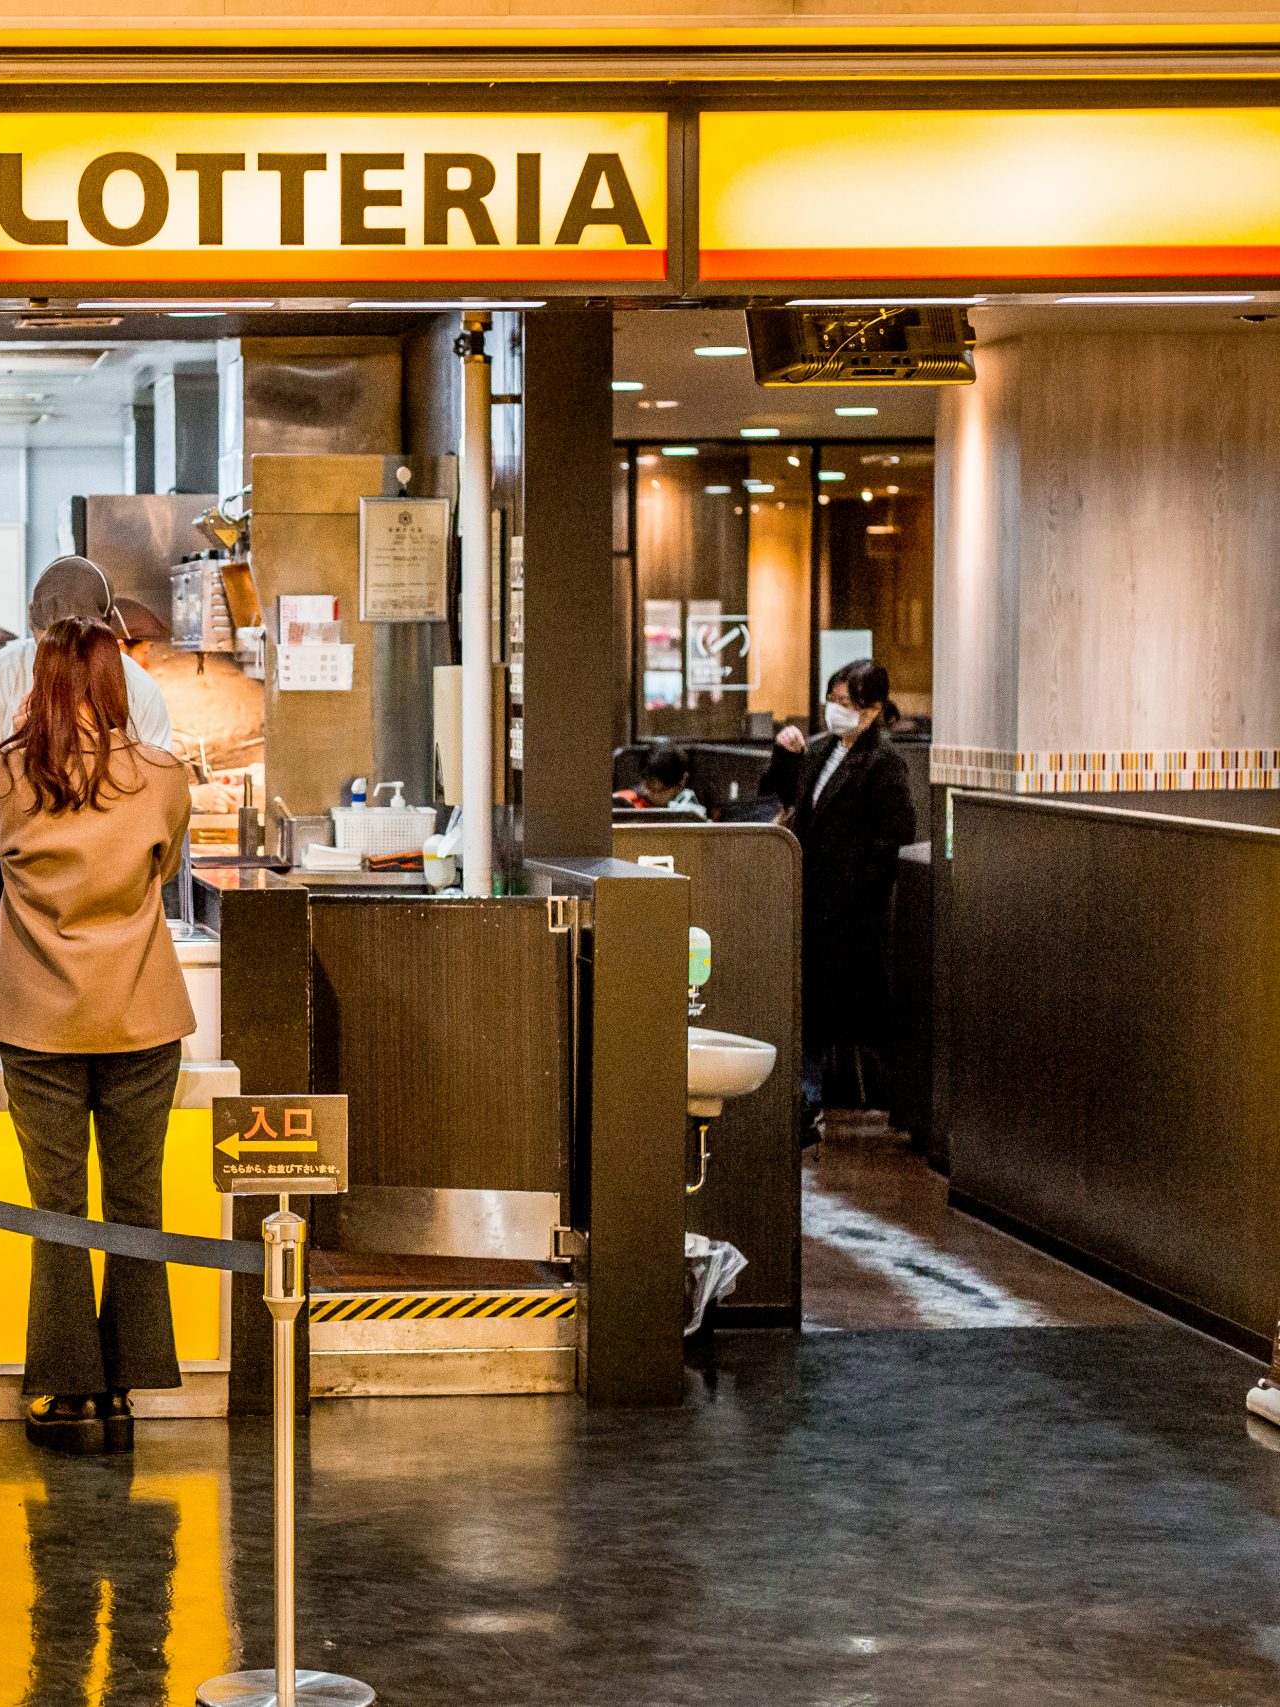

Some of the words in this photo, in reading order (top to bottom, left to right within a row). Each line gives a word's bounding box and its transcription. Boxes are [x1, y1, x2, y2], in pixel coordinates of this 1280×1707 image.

[244, 1106, 312, 1140] 入口
[223, 1164, 340, 1174] こちらから、お並び下さいませ。
